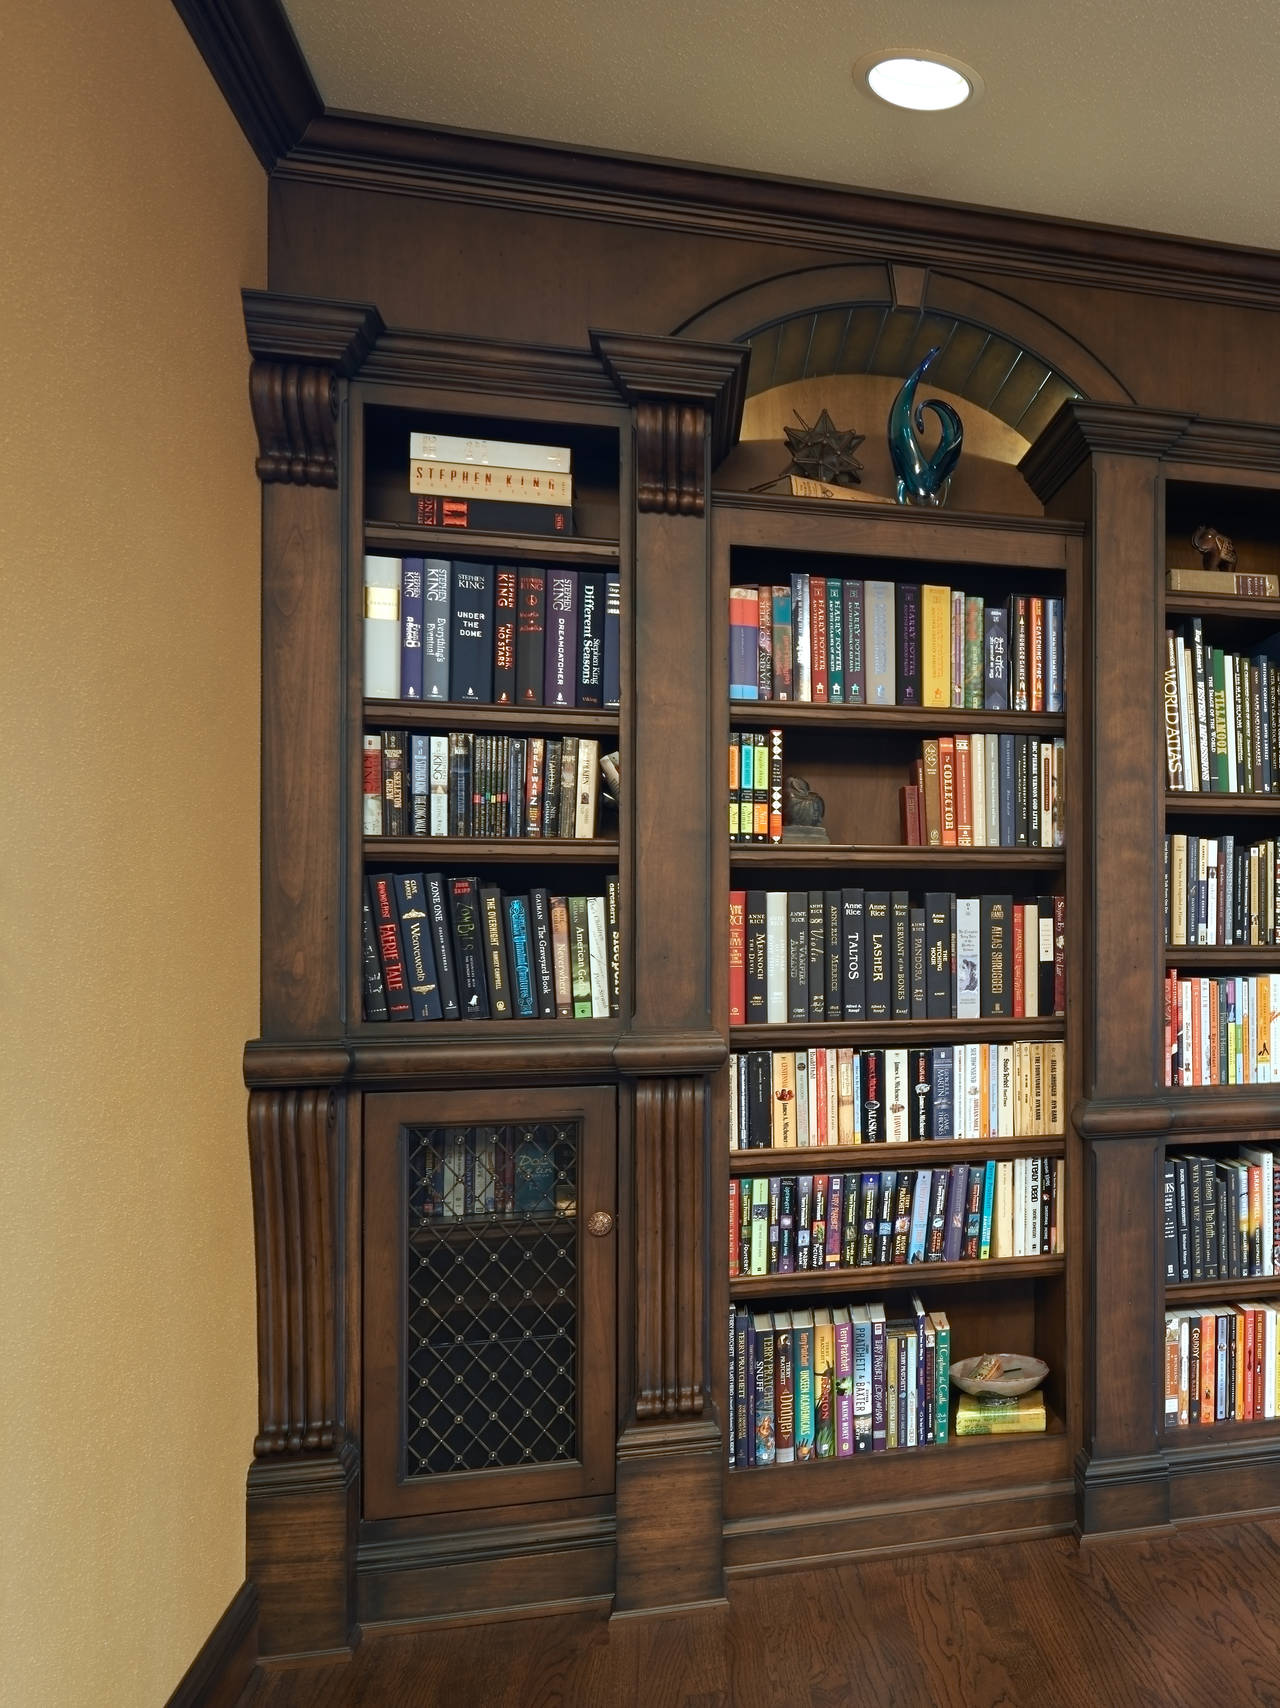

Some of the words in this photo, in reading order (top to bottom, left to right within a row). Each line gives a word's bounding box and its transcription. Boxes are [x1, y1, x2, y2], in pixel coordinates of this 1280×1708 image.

[416, 466, 492, 485] STEPHEN
[506, 475, 555, 490] KING
[405, 572, 414, 597] KING
[427, 569, 439, 601] KING
[439, 568, 447, 602] STEPHEN
[458, 580, 485, 590] KING
[498, 574, 509, 608] KING
[552, 578, 564, 611] KING
[563, 578, 572, 612] STEPHEN
[457, 611, 485, 620] UNDER
[583, 585, 594, 618] Different
[818, 600, 826, 634] HARRY
[833, 600, 842, 632] HARRY
[460, 629, 482, 638] DOME
[463, 620, 479, 629] THE
[498, 626, 506, 639] NO
[505, 623, 513, 643] FULL
[908, 604, 916, 639] HARRY
[427, 623, 435, 656] Eventual
[436, 618, 446, 662] Everything's
[498, 641, 506, 667] STARS
[557, 618, 566, 685] DREAMCATCHER
[592, 638, 600, 666] Stephen
[835, 637, 843, 671] POTTER
[582, 639, 593, 684] Seasons
[590, 667, 600, 685] King
[1165, 669, 1178, 724] WORLD
[1197, 681, 1207, 722] WESTERN
[1215, 690, 1228, 755] TILLAMOOK
[1168, 726, 1183, 773] ATLAS
[1199, 725, 1211, 780] IMPRESSIONS
[433, 755, 443, 780] KING
[386, 778, 394, 800] CREW
[414, 781, 427, 793] KING
[530, 796, 539, 806] Z
[531, 776, 539, 795] WAR
[943, 764, 954, 829] COLLECTOR
[414, 819, 427, 833] WALK
[430, 881, 441, 903] ZONE
[487, 897, 496, 909] THE
[433, 904, 443, 922] ONE
[490, 911, 499, 946] OVERNIGHT
[380, 924, 398, 961] FAERIE
[538, 925, 546, 939] The
[576, 926, 586, 967] American
[810, 928, 824, 962] Violin
[897, 922, 905, 956] SERVANT
[992, 926, 1002, 948] ATLAS
[540, 940, 550, 974] Graveyard
[556, 943, 568, 995] Neverwhere
[756, 933, 766, 980] MEMNOCH
[790, 939, 799, 978] ARMAND
[848, 932, 860, 980] TALTOS
[873, 934, 884, 982] LASHER
[386, 963, 402, 991] TALE
[542, 976, 551, 994] Book
[831, 954, 839, 991] MERRICK
[897, 974, 905, 1000] BONES
[992, 952, 1003, 993] SHRUGGED
[868, 1109, 877, 1135] ALASKA
[1192, 1164, 1200, 1183] WHY
[1206, 1208, 1216, 1220] The
[1206, 1220, 1216, 1238] Truth
[738, 1331, 746, 1354] TERRY
[763, 1335, 774, 1361] TERRY
[838, 1327, 849, 1342] Terry
[855, 1328, 866, 1371] PRATCHETT
[1192, 1327, 1201, 1359] CRUDDY
[840, 1344, 849, 1372] Pratchett
[738, 1356, 746, 1399] PRATCHETT
[756, 1361, 764, 1391] SNUFF
[801, 1370, 810, 1392] UNSEEN
[778, 1394, 794, 1432] Dodger
[841, 1400, 850, 1420] MAKING
[855, 1382, 866, 1412] BAXTER
[801, 1394, 811, 1435] ACADEMICALS
